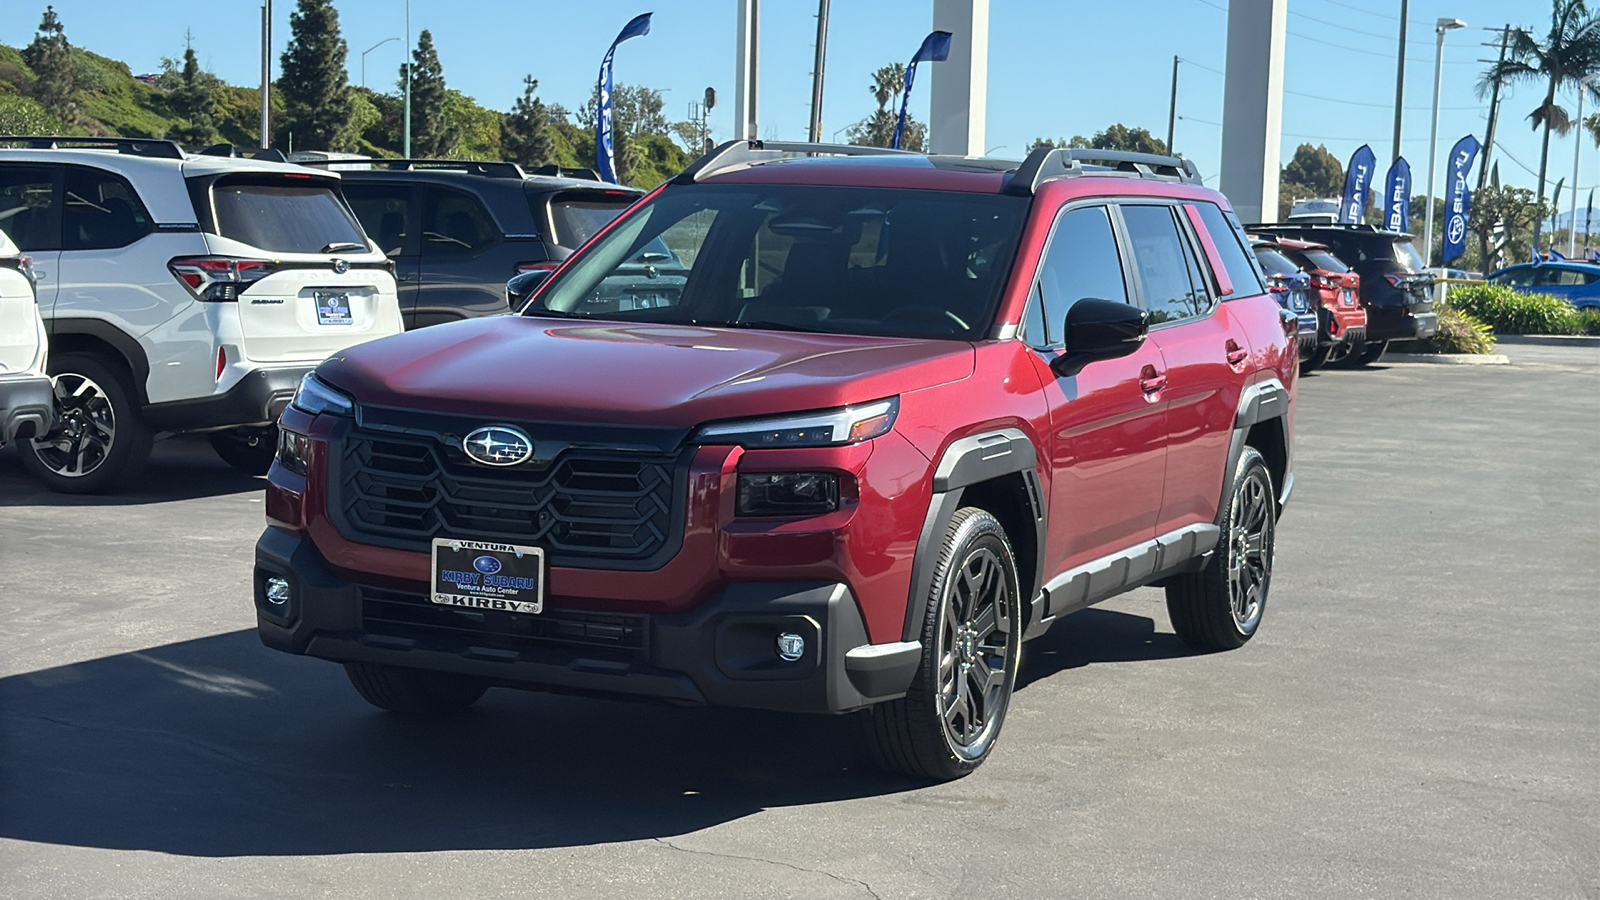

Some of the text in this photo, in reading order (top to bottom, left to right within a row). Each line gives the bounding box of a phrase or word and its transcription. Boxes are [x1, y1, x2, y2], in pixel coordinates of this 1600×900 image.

[1348, 164, 1367, 225] UBARU
[1389, 176, 1405, 233] UBARU
[460, 541, 515, 552] VENTURA
[442, 570, 534, 590] KIRBY SUBARU
[456, 582, 519, 595] Ventura Auto Center
[453, 596, 521, 610] KIRBY
